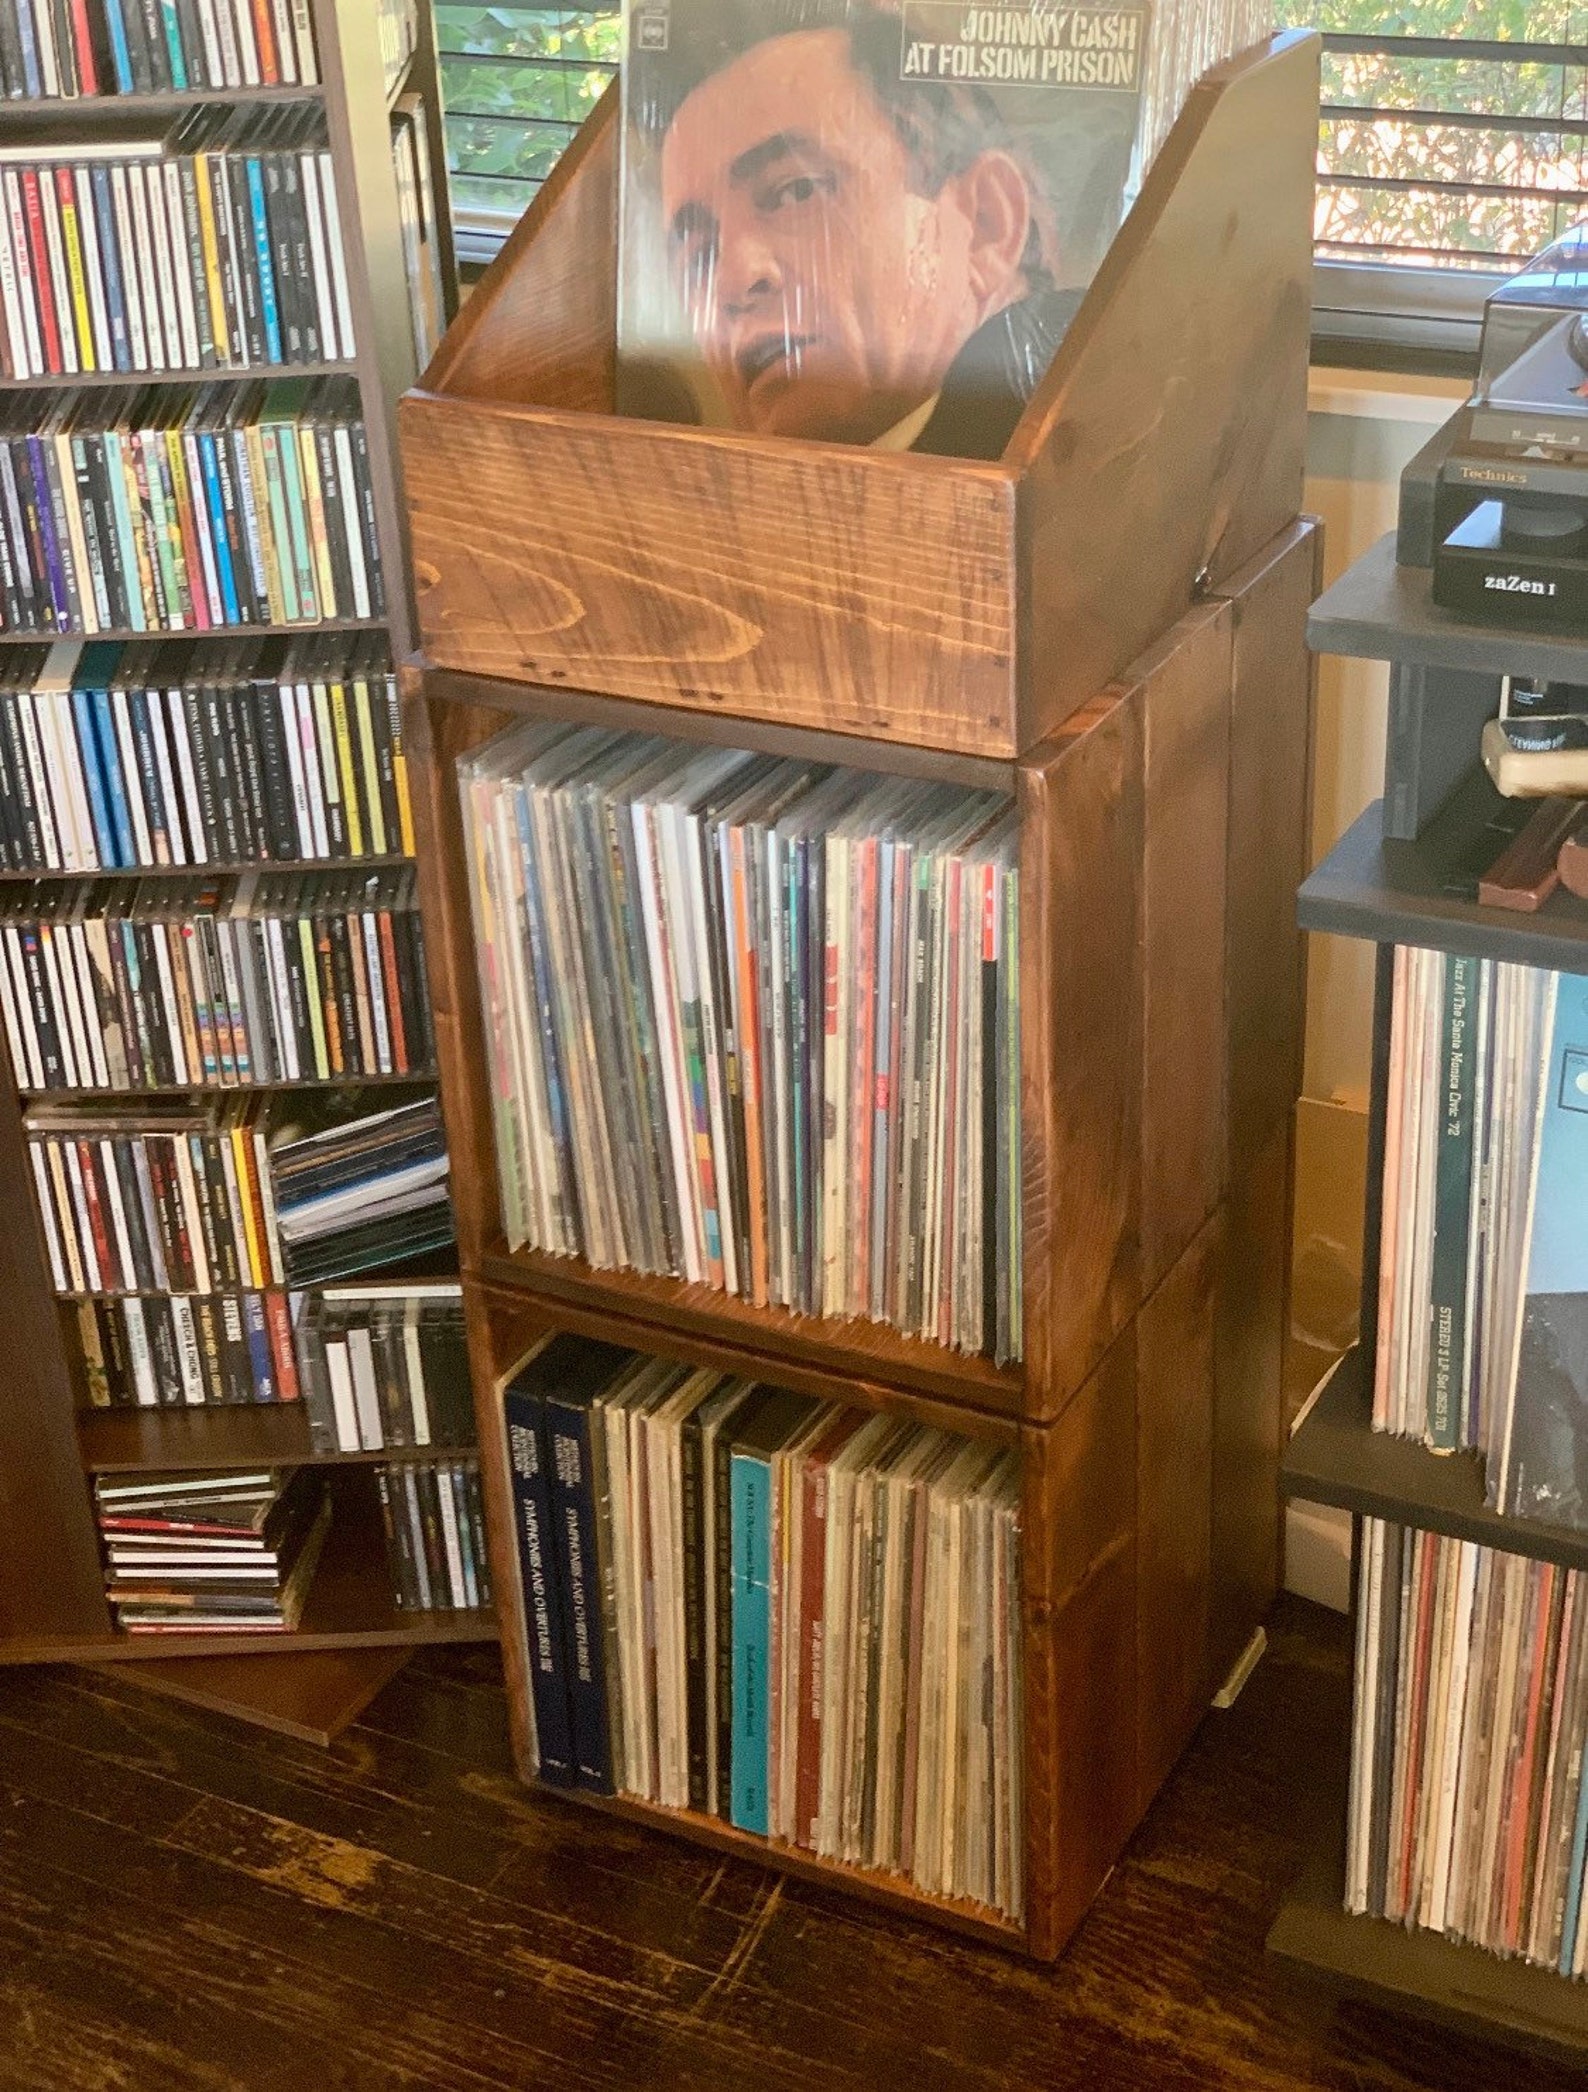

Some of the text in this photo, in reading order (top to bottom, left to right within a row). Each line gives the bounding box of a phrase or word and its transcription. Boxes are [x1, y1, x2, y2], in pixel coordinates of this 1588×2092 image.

[961, 9, 1136, 50] JOHNNY CASH
[905, 43, 1134, 84] AT FOLSOM PRISON
[1460, 467, 1527, 484] Technics
[1485, 575, 1545, 595] zaZen
[1453, 997, 1465, 1016] The
[1450, 1019, 1464, 1049] Santa
[1449, 1051, 1463, 1088] Monica
[1448, 1091, 1461, 1116] Civic
[1437, 1306, 1451, 1347] STEREO
[186, 1349, 199, 1379] CHONG
[528, 1567, 546, 1596] AND
[570, 1577, 585, 1605] AND
